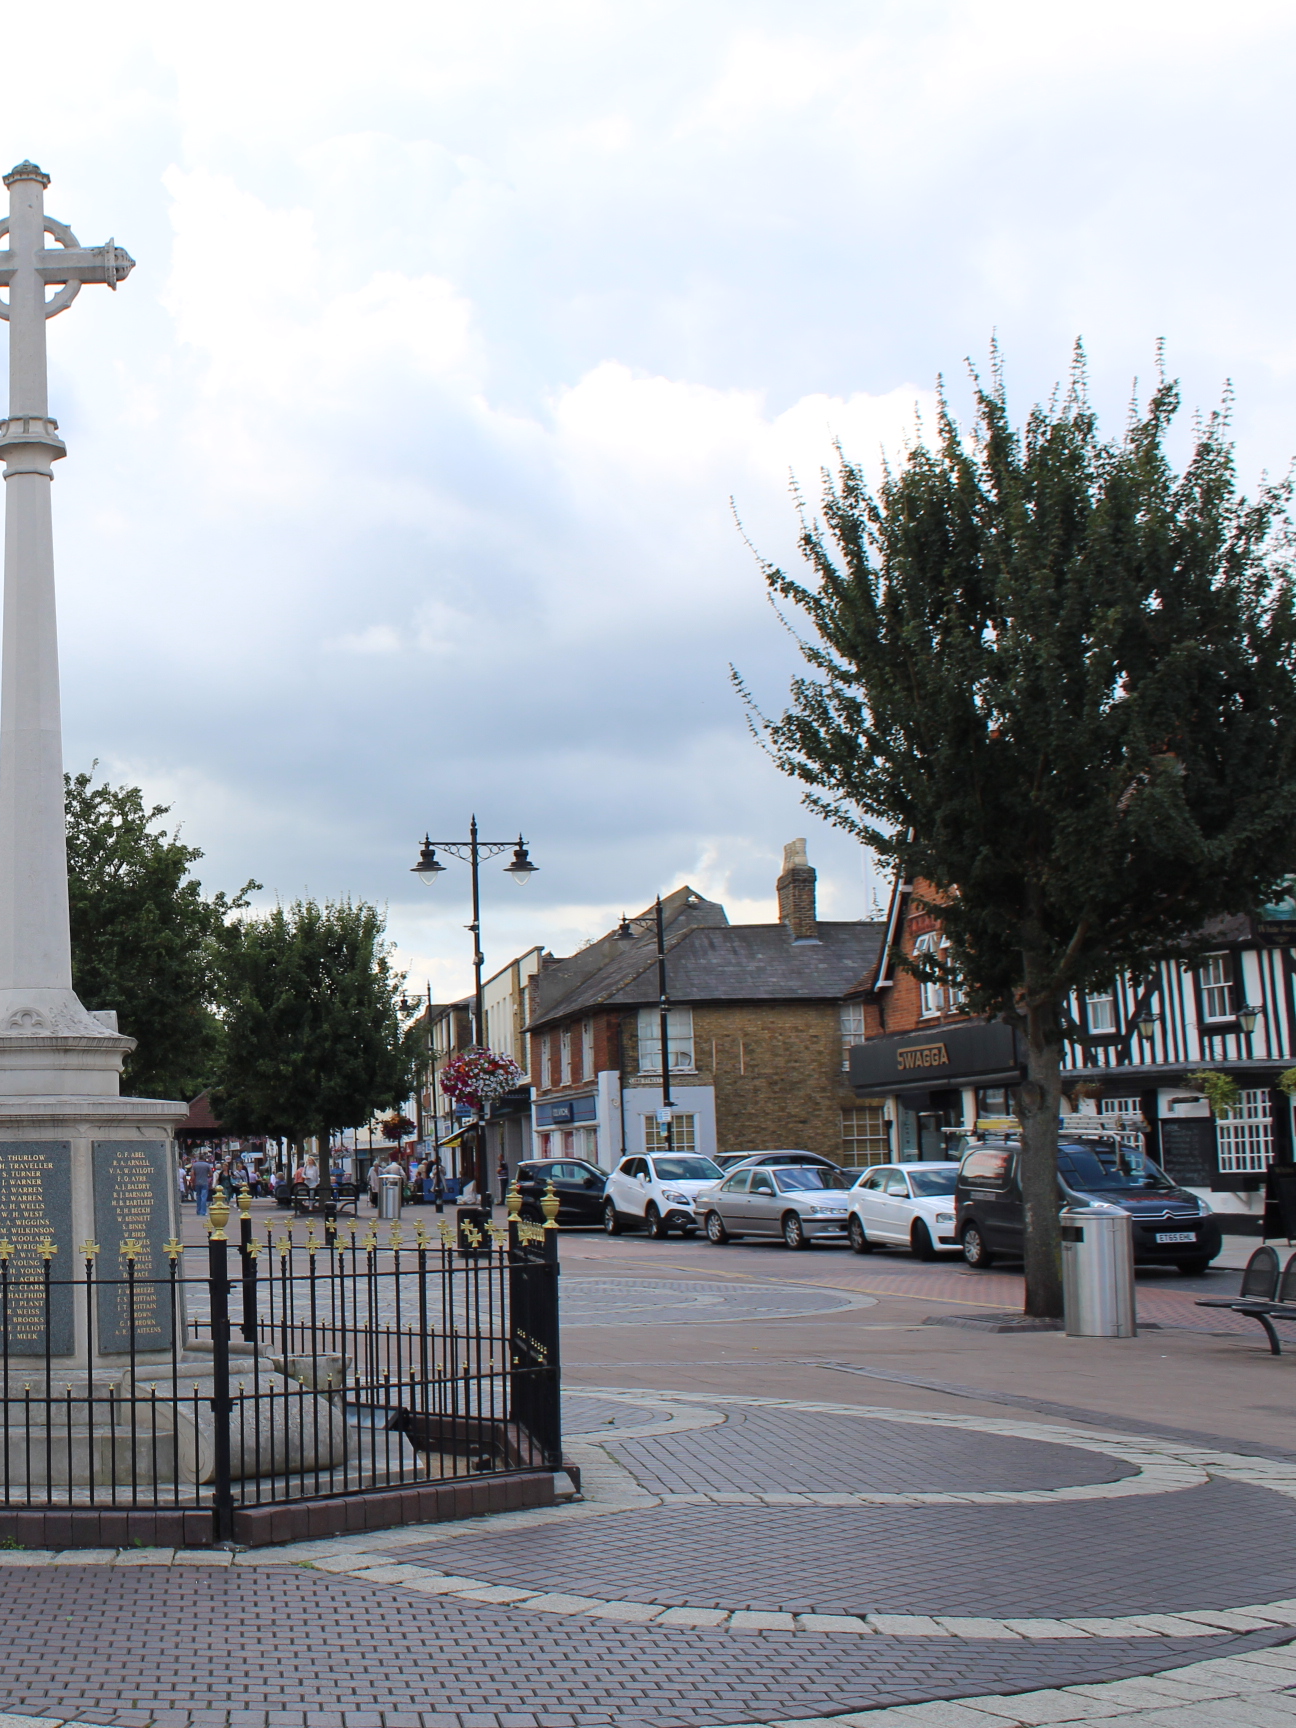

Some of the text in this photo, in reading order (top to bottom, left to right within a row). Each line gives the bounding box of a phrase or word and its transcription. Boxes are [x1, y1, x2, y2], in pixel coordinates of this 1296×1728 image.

[897, 1043, 950, 1070] SWAGGA
[1159, 1233, 1192, 1242] ET65 EHL
